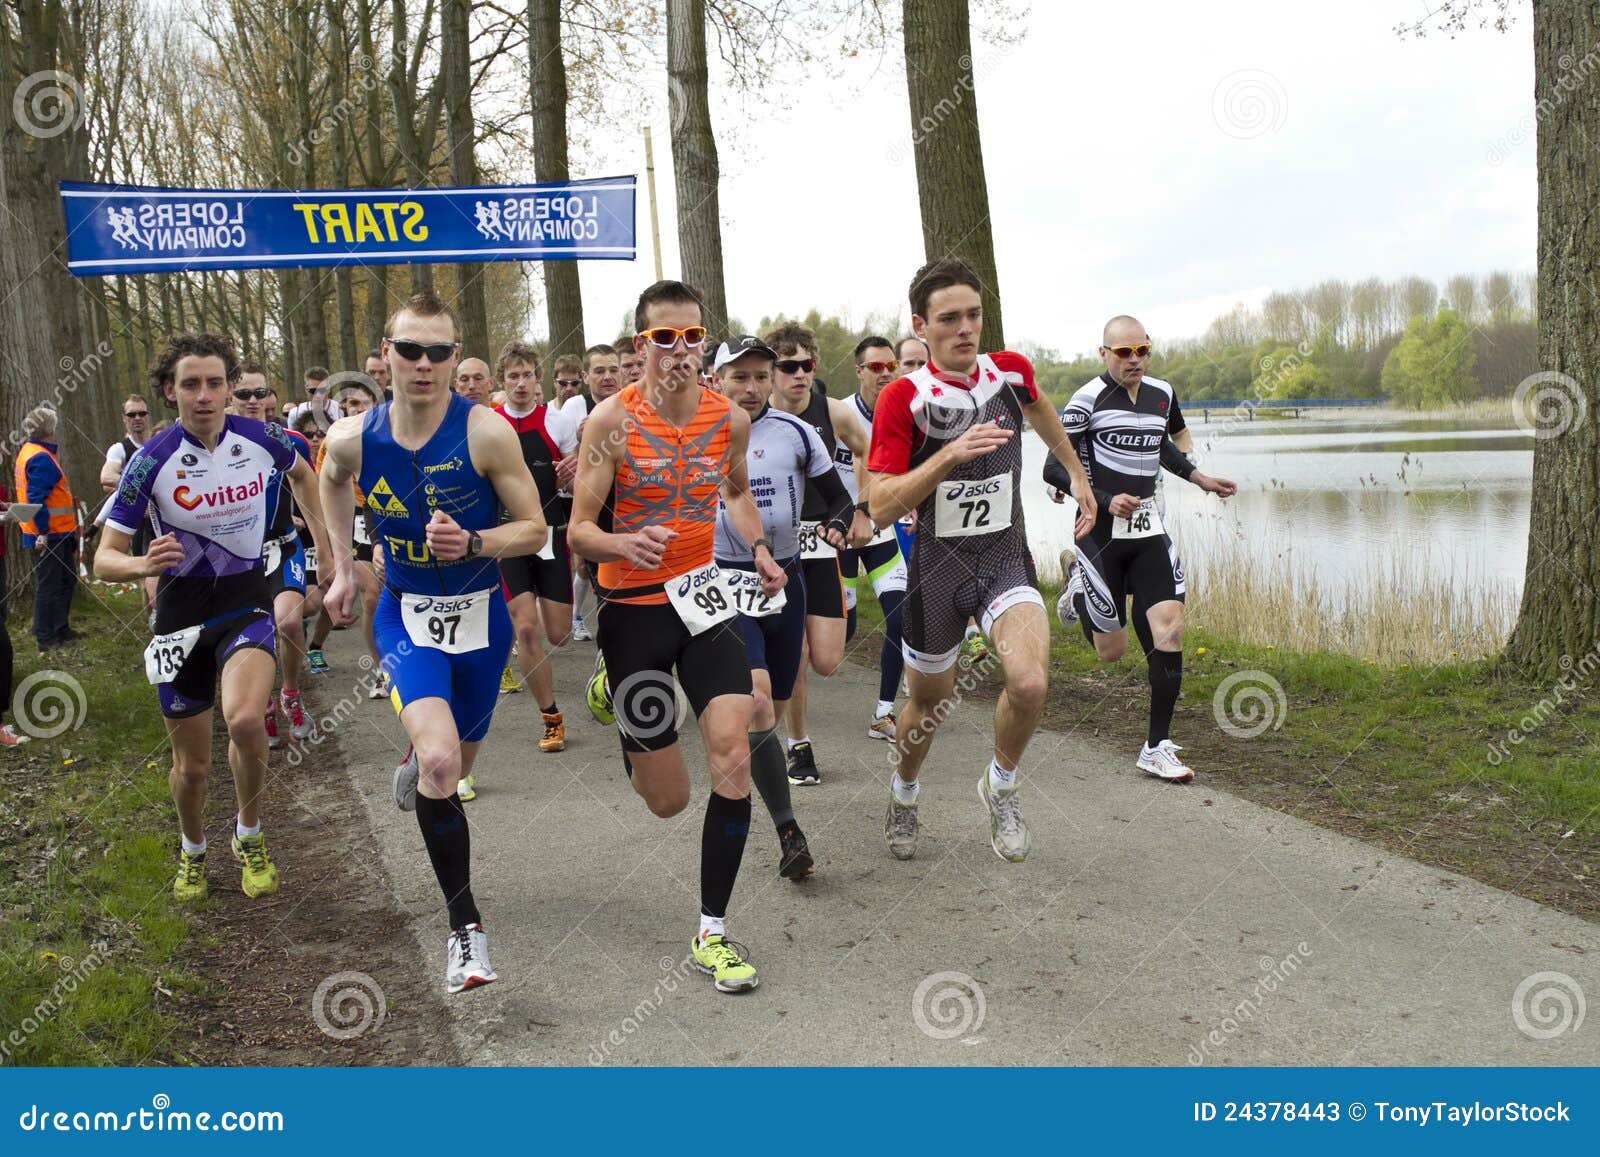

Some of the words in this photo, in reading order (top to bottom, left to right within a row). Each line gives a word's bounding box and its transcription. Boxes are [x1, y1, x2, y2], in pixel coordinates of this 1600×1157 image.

[1106, 432, 1141, 446] CYCLE
[204, 472, 264, 507] vitaal
[959, 500, 990, 528] 72
[693, 586, 728, 617] 99
[732, 588, 771, 612] 172
[428, 614, 461, 645] 97
[153, 645, 185, 675] 133
